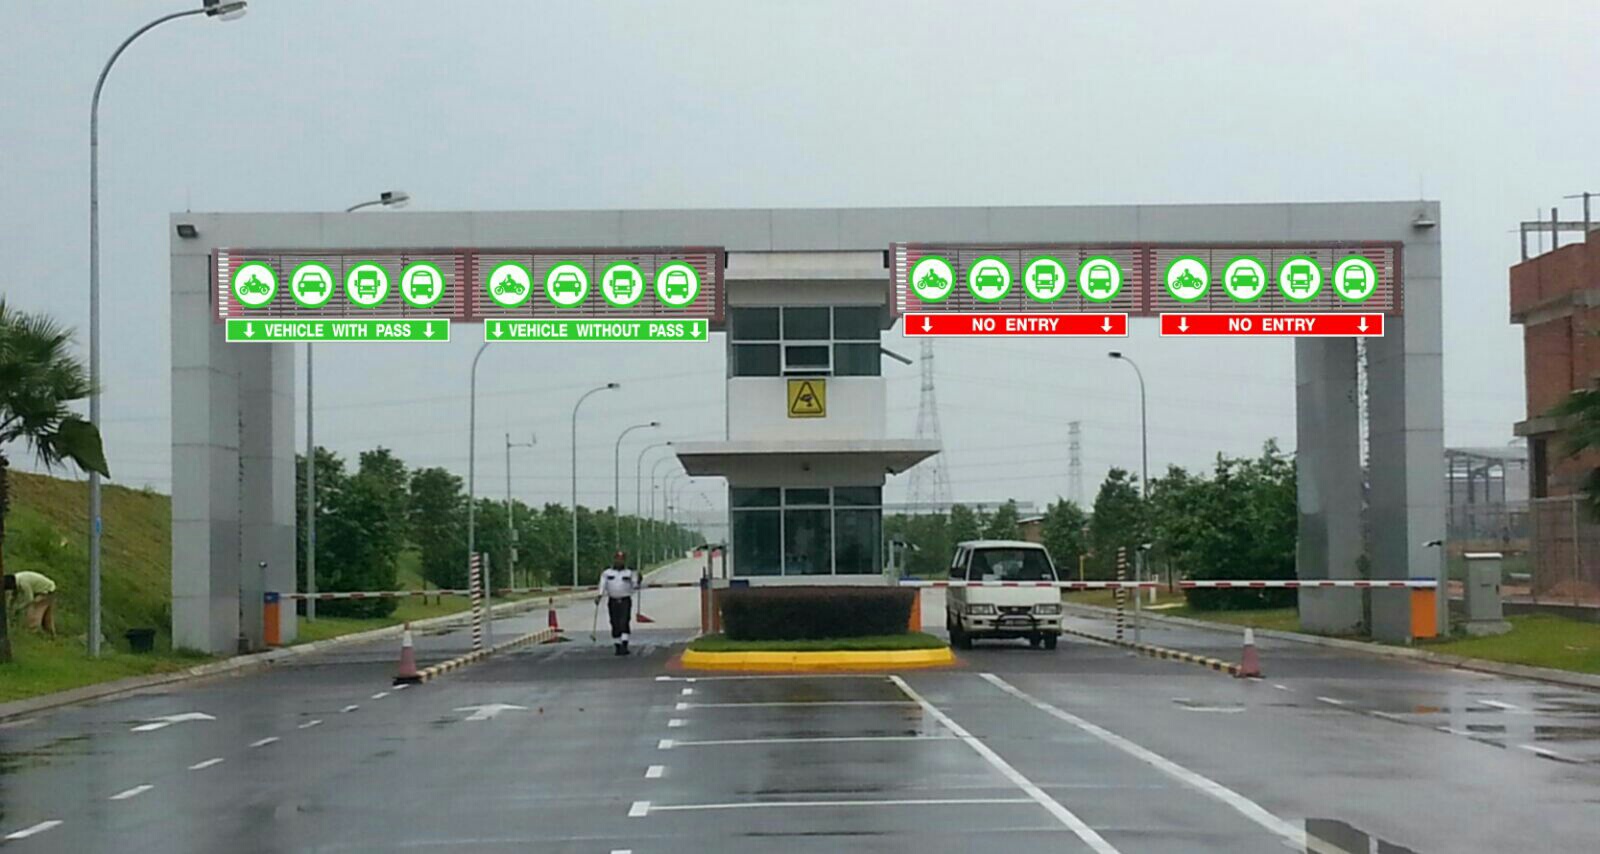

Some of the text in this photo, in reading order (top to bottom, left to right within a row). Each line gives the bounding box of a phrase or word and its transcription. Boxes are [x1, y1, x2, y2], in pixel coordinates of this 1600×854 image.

[264, 323, 412, 338] VEHICLE WITH PASS
[508, 323, 685, 338] VEHICLE WITHOUT PASS
[972, 317, 1060, 332] NO ENTRY
[1228, 317, 1316, 332] NO ENTRY
